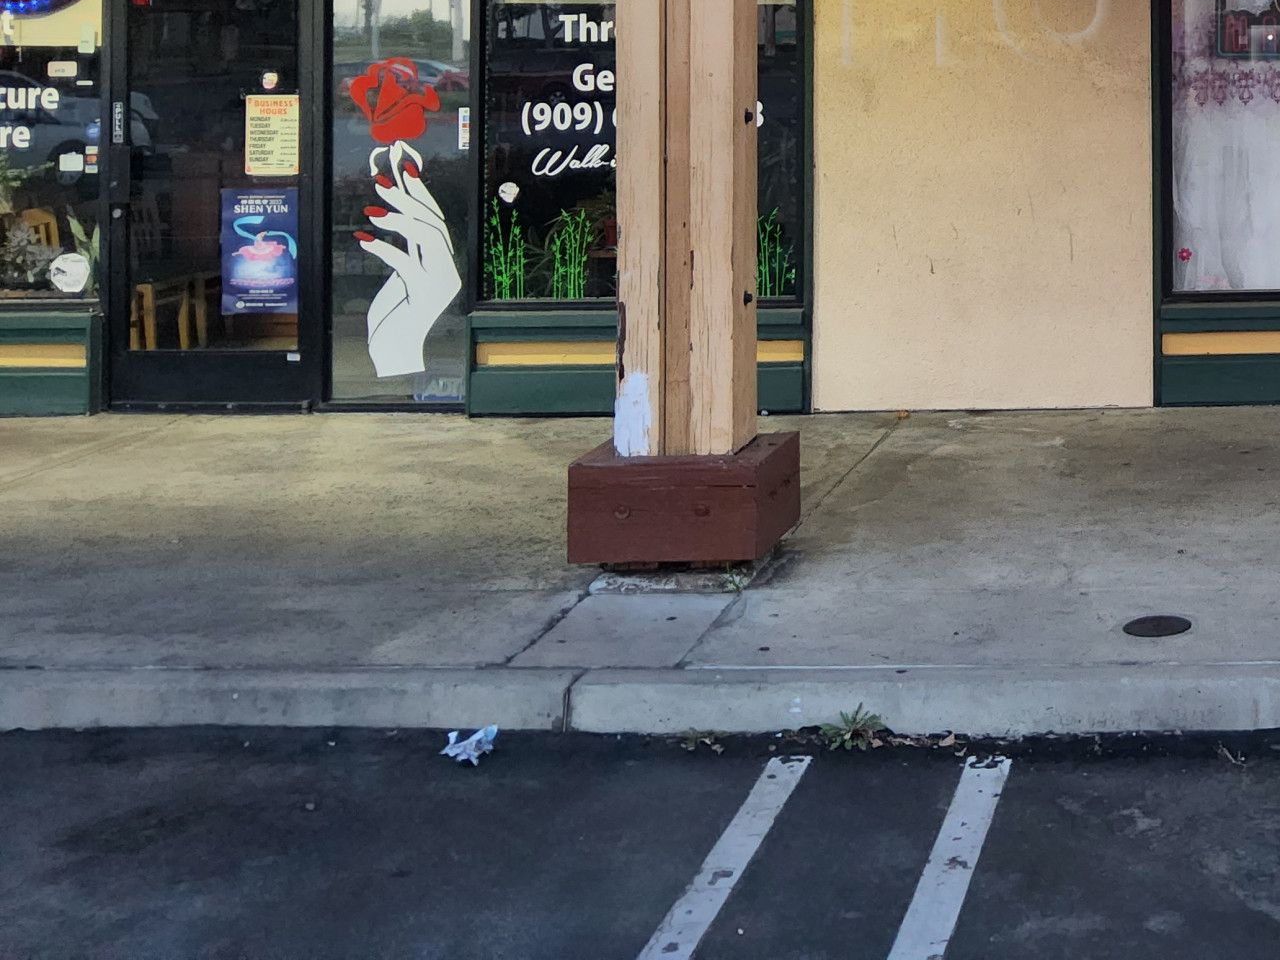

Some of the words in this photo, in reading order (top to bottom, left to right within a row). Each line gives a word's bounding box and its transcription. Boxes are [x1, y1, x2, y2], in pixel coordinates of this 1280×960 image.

[558, 13, 616, 43] Thr
[521, 101, 603, 135] (909)
[234, 205, 263, 213] SHEN
[266, 205, 288, 213] YUN
